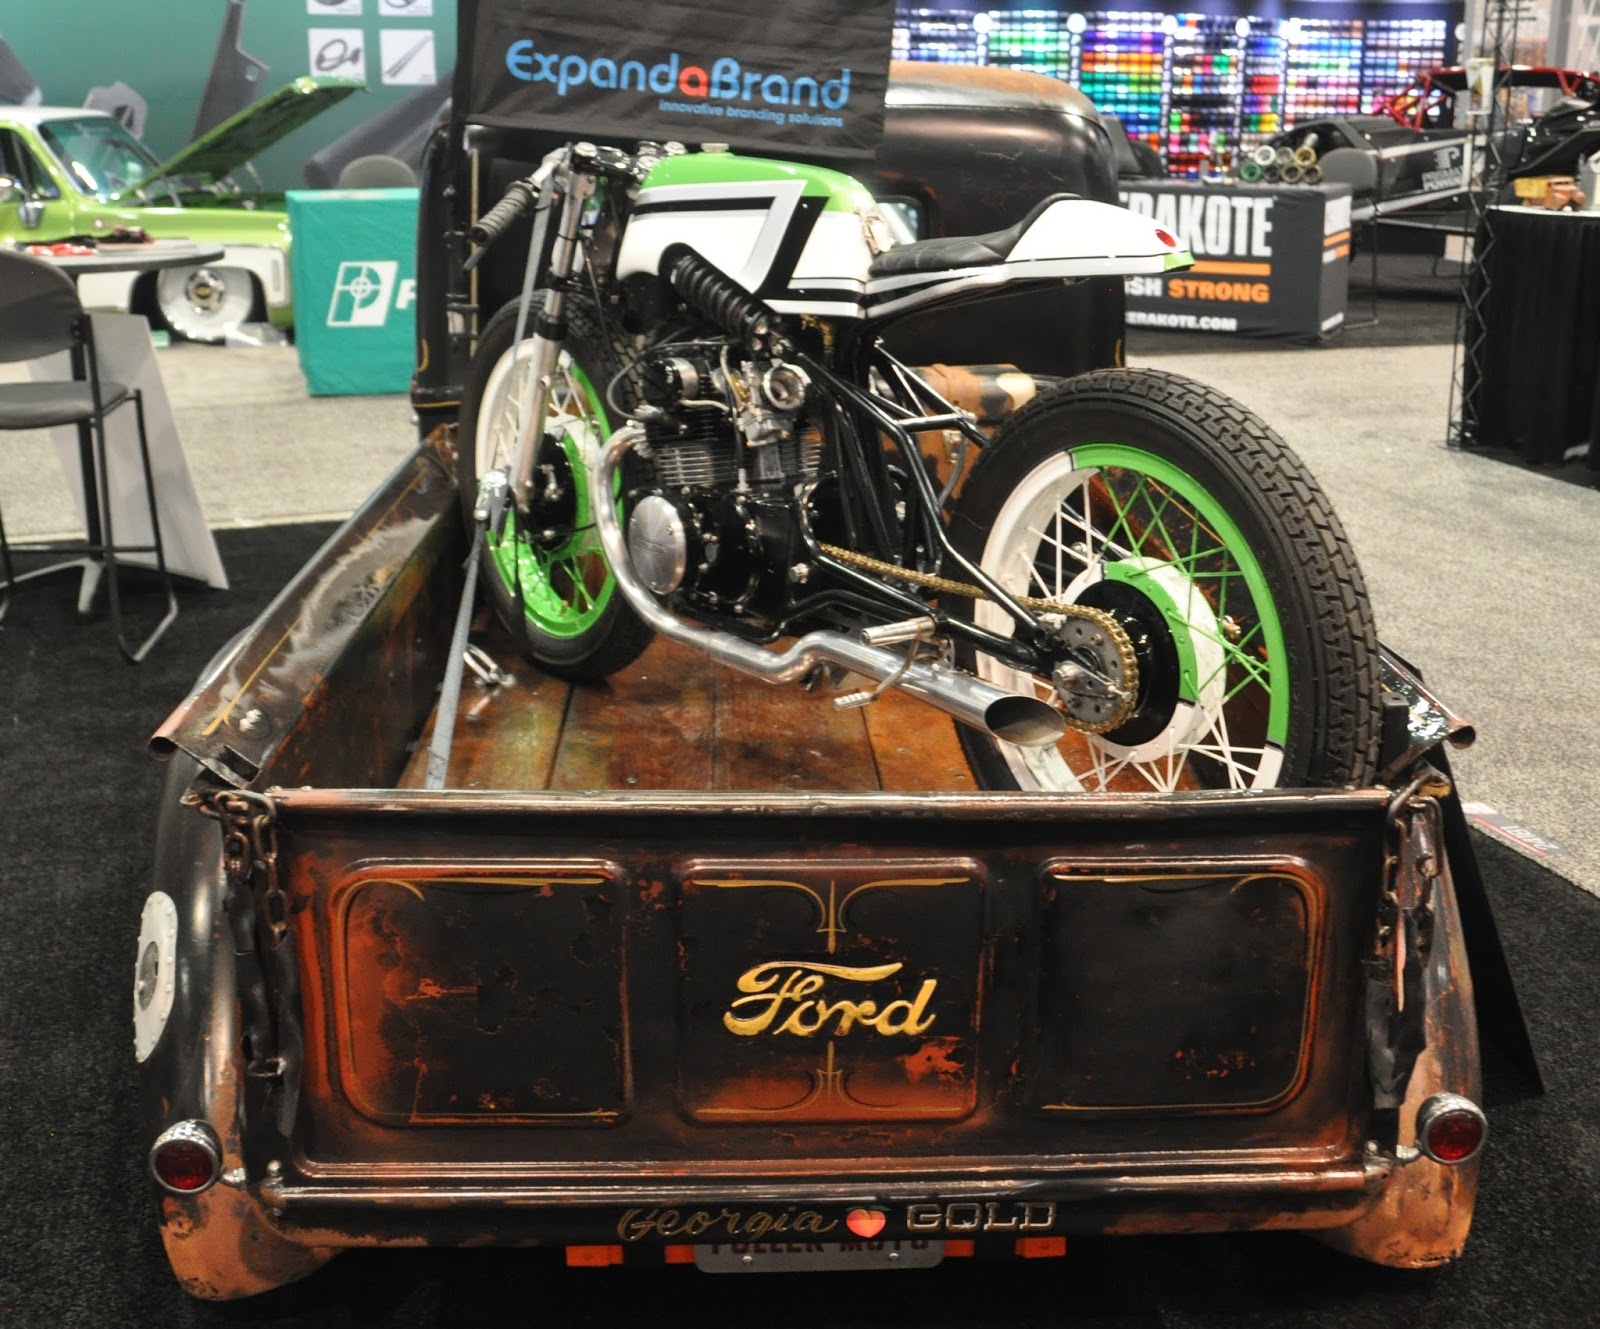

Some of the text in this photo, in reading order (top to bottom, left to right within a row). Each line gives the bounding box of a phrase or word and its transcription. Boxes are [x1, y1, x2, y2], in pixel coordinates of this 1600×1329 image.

[506, 38, 852, 111] ExpandaBrand
[726, 105, 786, 126] branding
[788, 111, 845, 128] solutions
[1167, 277, 1271, 304] STRONG
[722, 960, 938, 1037] Ford
[616, 1201, 1057, 1242] Georgia GOLD
